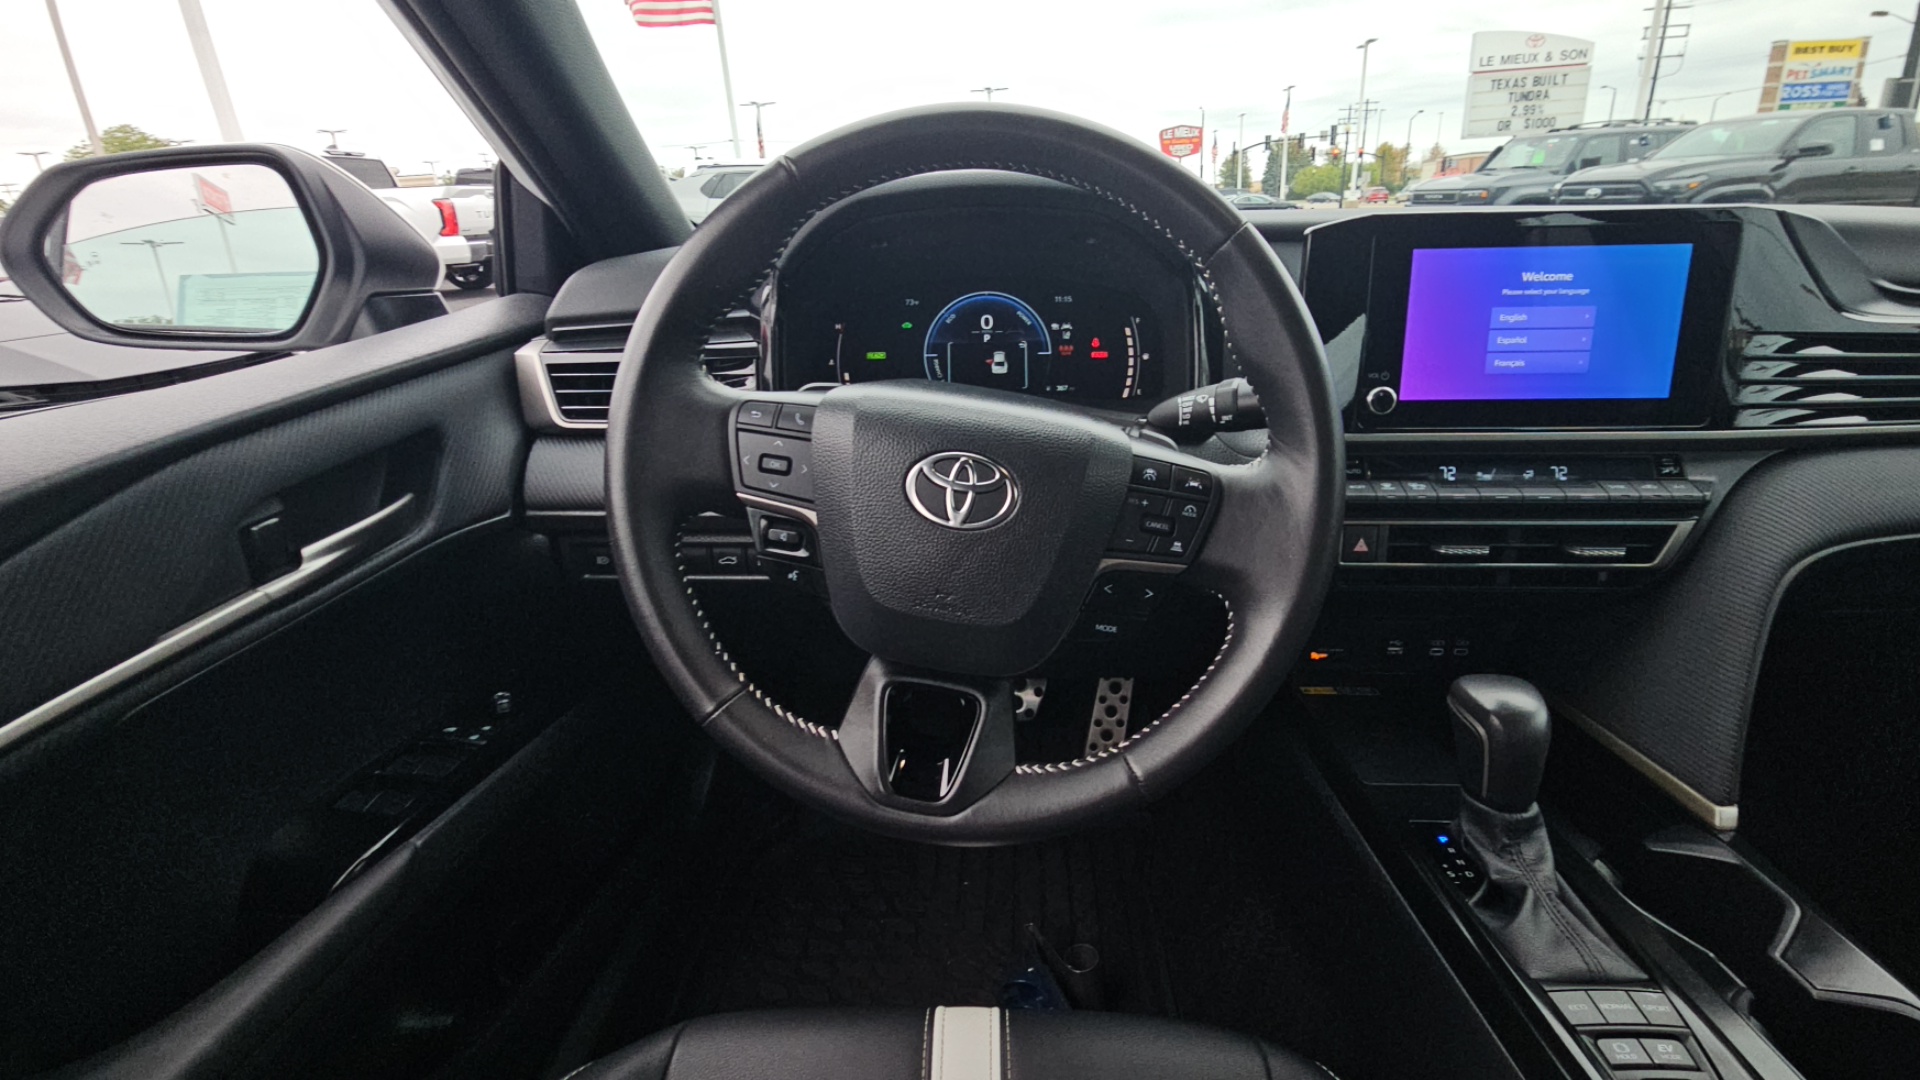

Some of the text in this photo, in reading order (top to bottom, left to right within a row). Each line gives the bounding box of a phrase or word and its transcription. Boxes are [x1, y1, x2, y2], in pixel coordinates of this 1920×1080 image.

[1794, 45, 1857, 55] BEST BUY
[1479, 49, 1589, 67] LE MIEUX & SON
[1490, 73, 1569, 90] TEXAS BUILT
[1508, 89, 1550, 103] TUNDRA
[1781, 84, 1822, 99] ROSS
[1497, 117, 1557, 132] OR $1000
[1522, 271, 1574, 282] Welcome
[1502, 288, 1523, 296] Please
[1558, 288, 1591, 296] language
[980, 314, 994, 330] 0
[1499, 314, 1528, 323] English
[983, 334, 991, 343] P
[1494, 359, 1526, 368] Français
[1439, 466, 1457, 481] 72
[1550, 465, 1568, 481] 72
[1145, 520, 1171, 531] CANCEL
[1095, 624, 1118, 633] MODE
[1568, 1003, 1588, 1011] ECO
[1642, 1004, 1670, 1013] SPORT
[1657, 1044, 1674, 1053] EV
